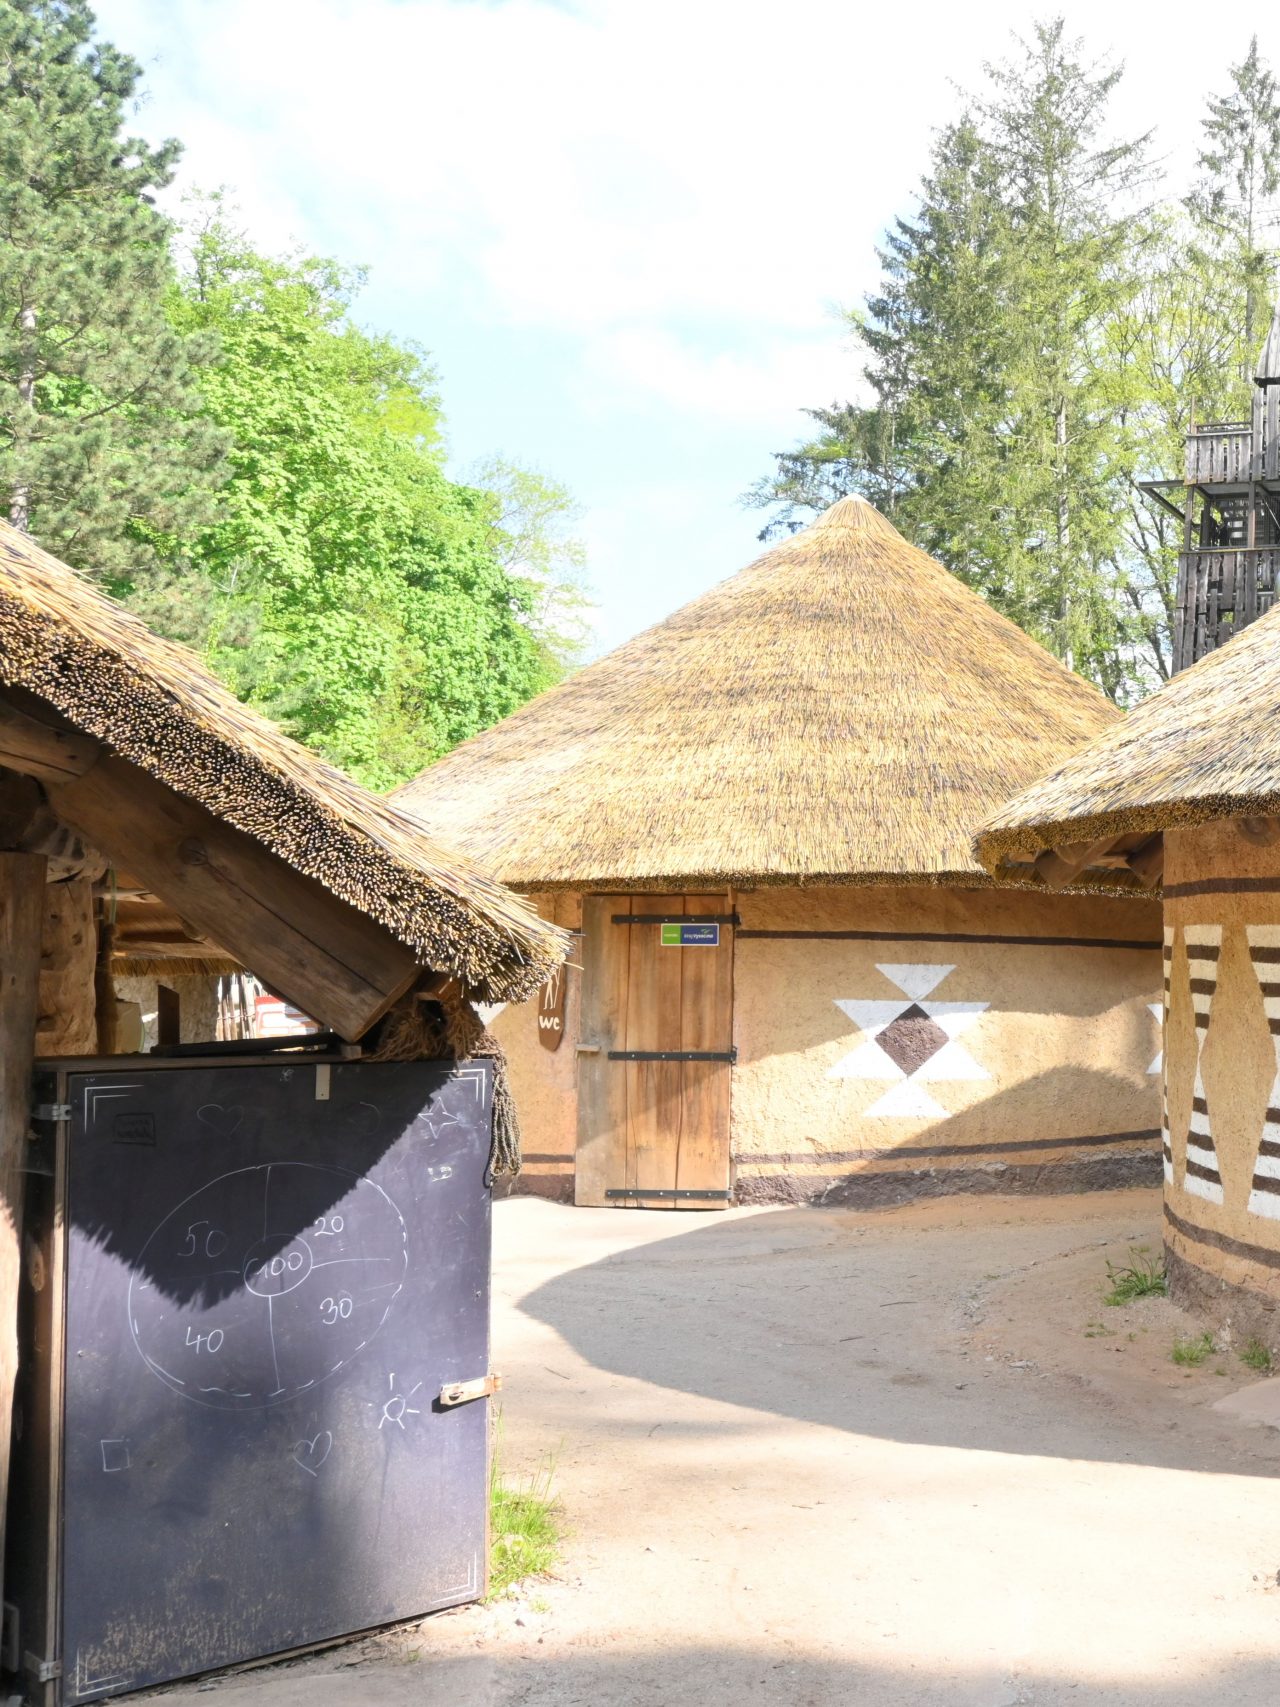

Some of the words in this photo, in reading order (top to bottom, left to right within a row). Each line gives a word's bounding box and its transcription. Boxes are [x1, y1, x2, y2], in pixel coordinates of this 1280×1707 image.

[539, 1015, 561, 1030] WC
[177, 1220, 229, 1258] 50
[314, 1215, 345, 1237] 20
[256, 1252, 303, 1279] 100
[320, 1297, 353, 1325] 30
[186, 1326, 224, 1354] 40
